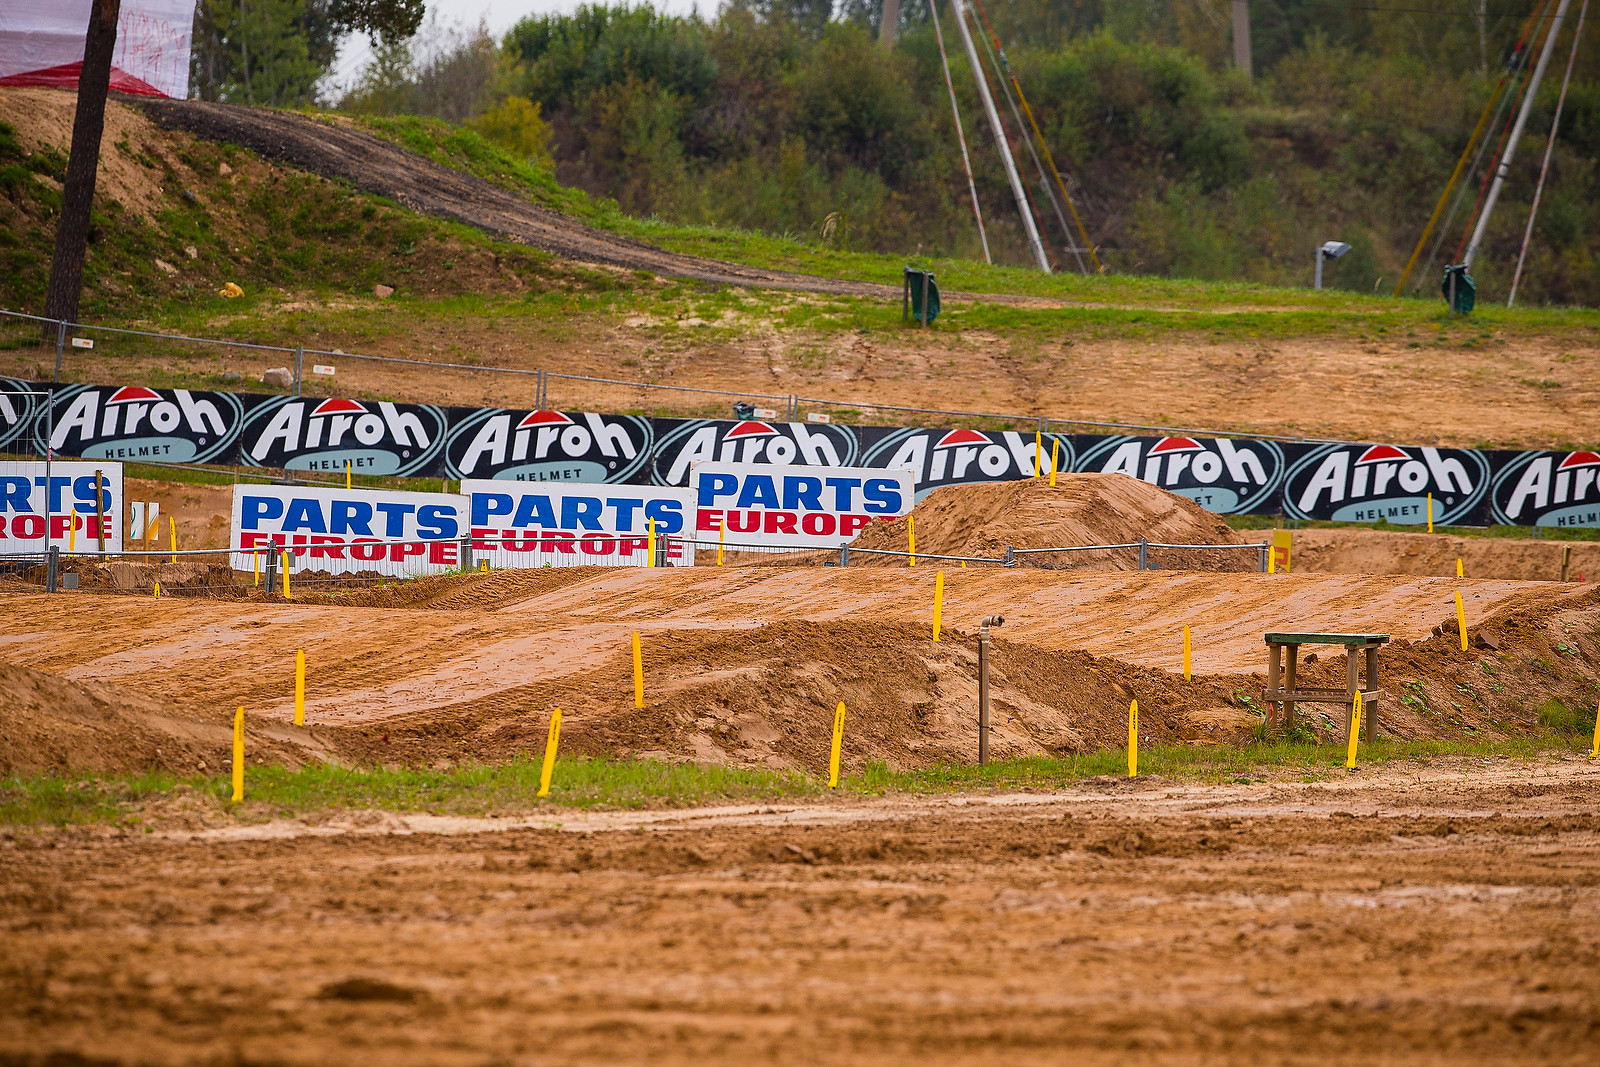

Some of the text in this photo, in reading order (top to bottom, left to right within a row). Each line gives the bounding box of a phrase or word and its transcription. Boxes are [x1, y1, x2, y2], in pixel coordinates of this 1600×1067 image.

[50, 387, 227, 450] Airoh
[251, 399, 431, 461] Airoh
[105, 445, 171, 459] HELMET
[309, 457, 375, 470] HELMET
[458, 411, 637, 475] Airoh
[665, 422, 842, 486] Airoh
[885, 430, 1053, 484] Airoh
[1100, 438, 1268, 485] Airoh
[516, 468, 582, 481] HELMET
[699, 473, 903, 514] PARTS
[1297, 446, 1474, 513] Airoh
[1504, 453, 1600, 520] Air
[0, 515, 112, 539] OPE
[240, 496, 459, 540] PARTS
[471, 493, 684, 534] PARTS
[696, 509, 902, 537] EUROP
[1355, 505, 1420, 520] HELMET
[1557, 512, 1600, 526] HELM
[240, 532, 458, 565] EUROPE
